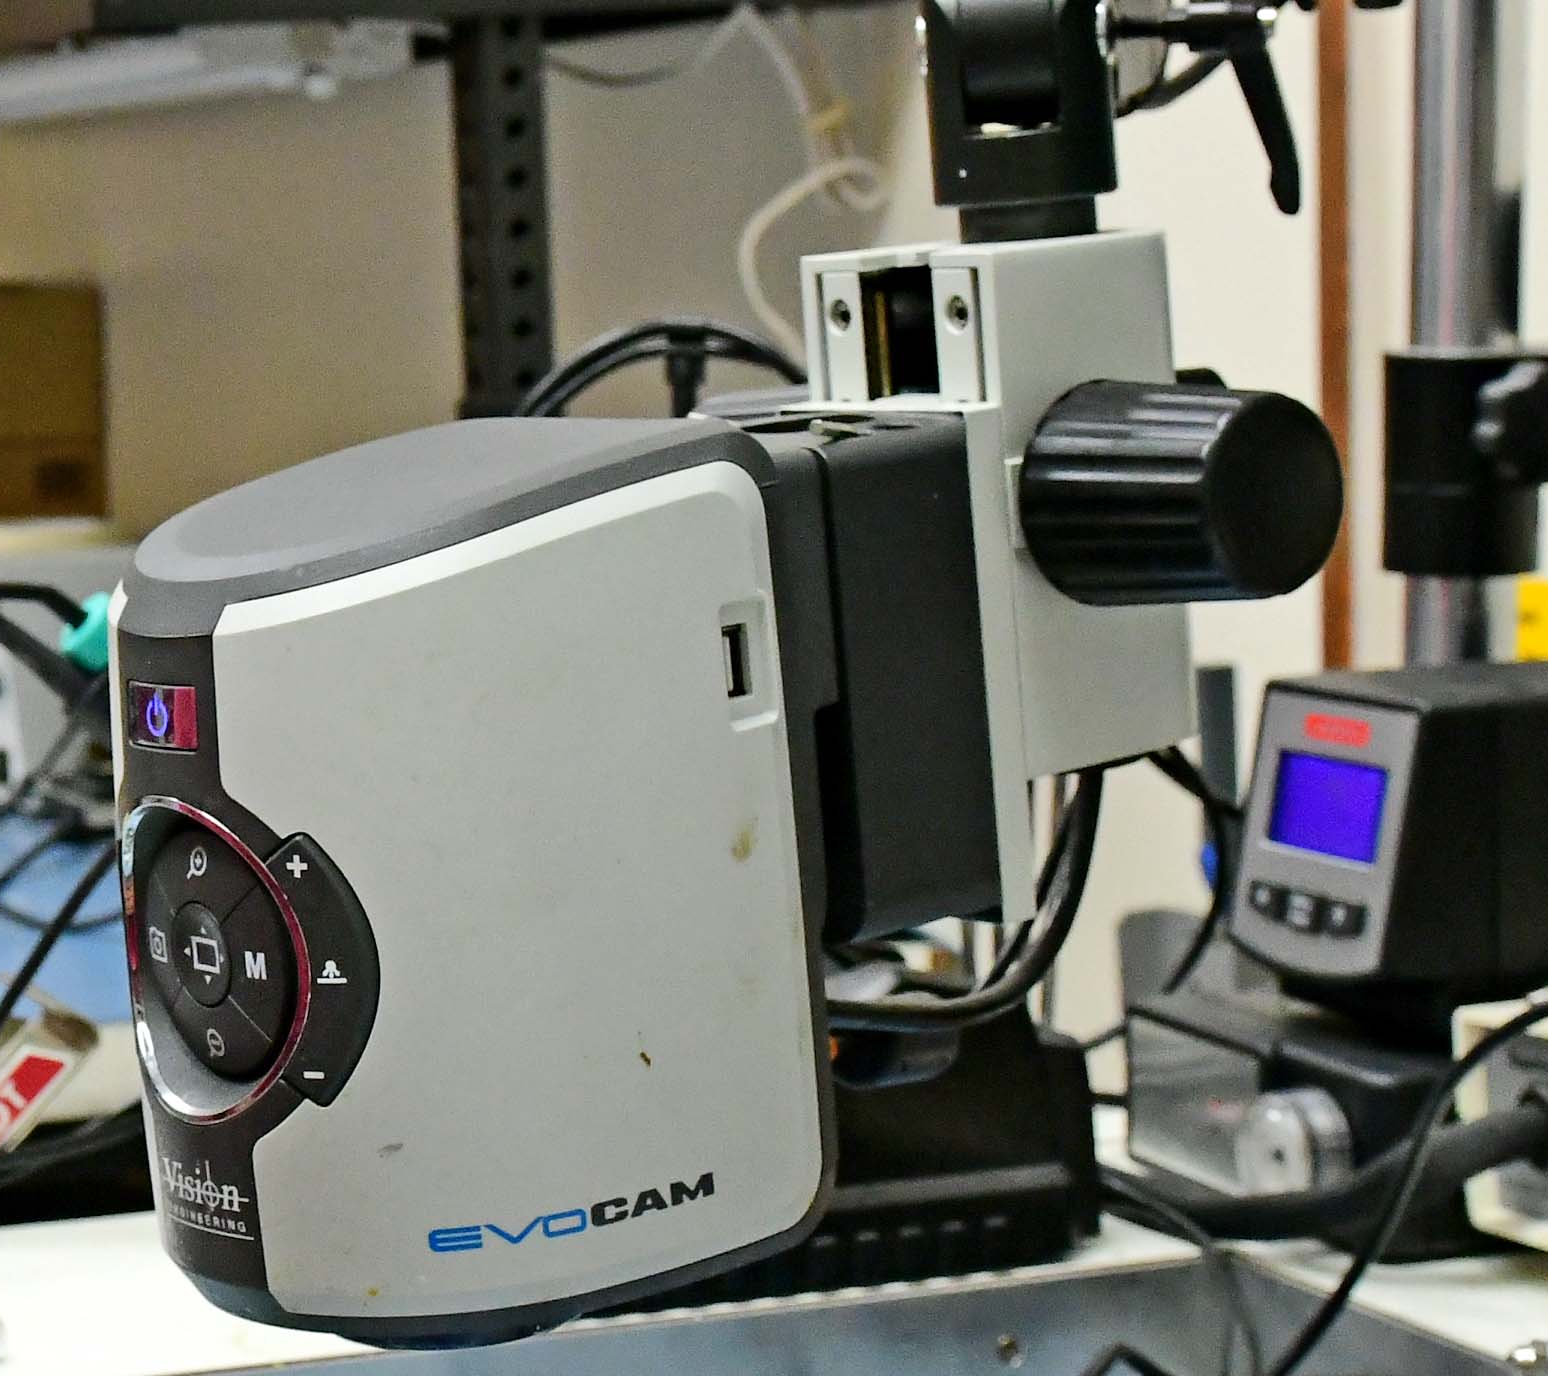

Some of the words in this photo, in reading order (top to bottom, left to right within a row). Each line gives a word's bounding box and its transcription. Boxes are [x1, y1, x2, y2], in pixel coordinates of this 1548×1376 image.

[244, 951, 267, 980] M
[161, 1157, 242, 1212] Vision
[427, 1170, 716, 1253] EVOCAM
